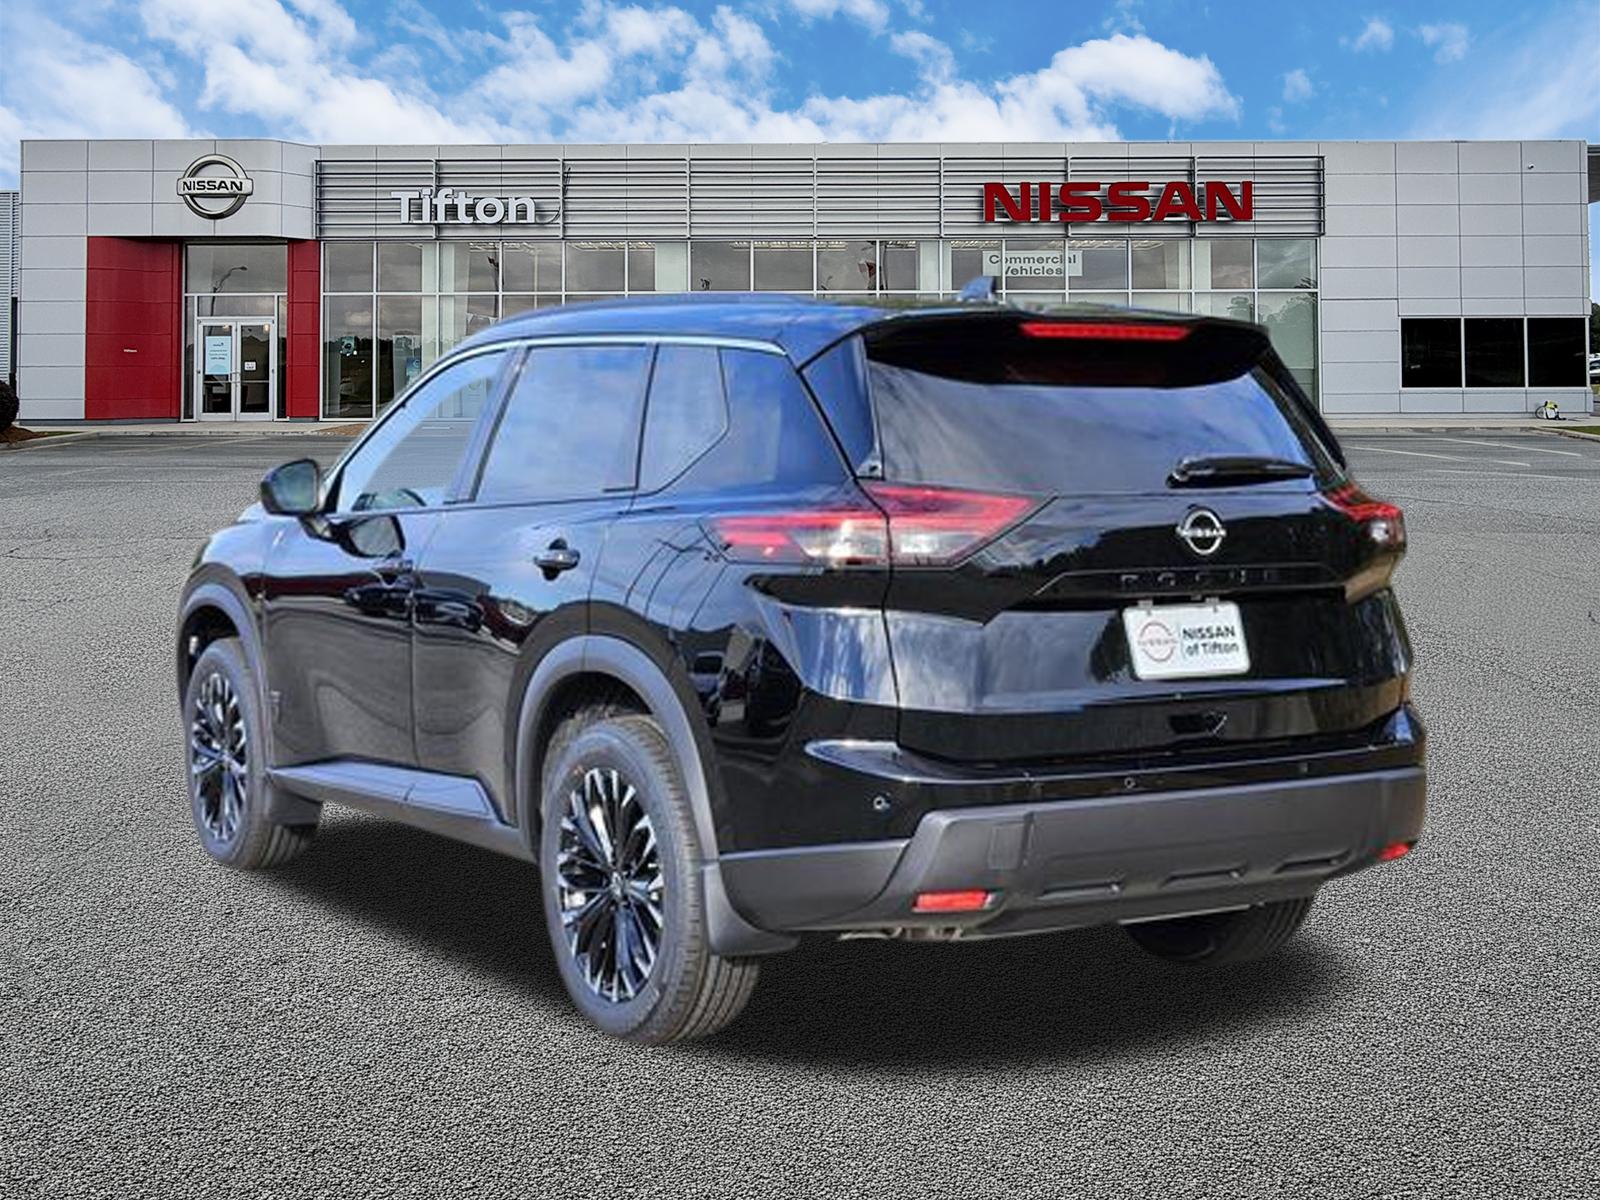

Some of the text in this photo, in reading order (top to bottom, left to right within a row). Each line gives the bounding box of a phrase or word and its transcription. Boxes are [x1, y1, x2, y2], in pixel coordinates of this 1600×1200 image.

[182, 180, 243, 191] NISSAN
[391, 187, 536, 224] Tifton
[983, 181, 1253, 222] NISSAN
[1182, 625, 1235, 639] NISSAN
[1185, 641, 1240, 657] of Tifton
